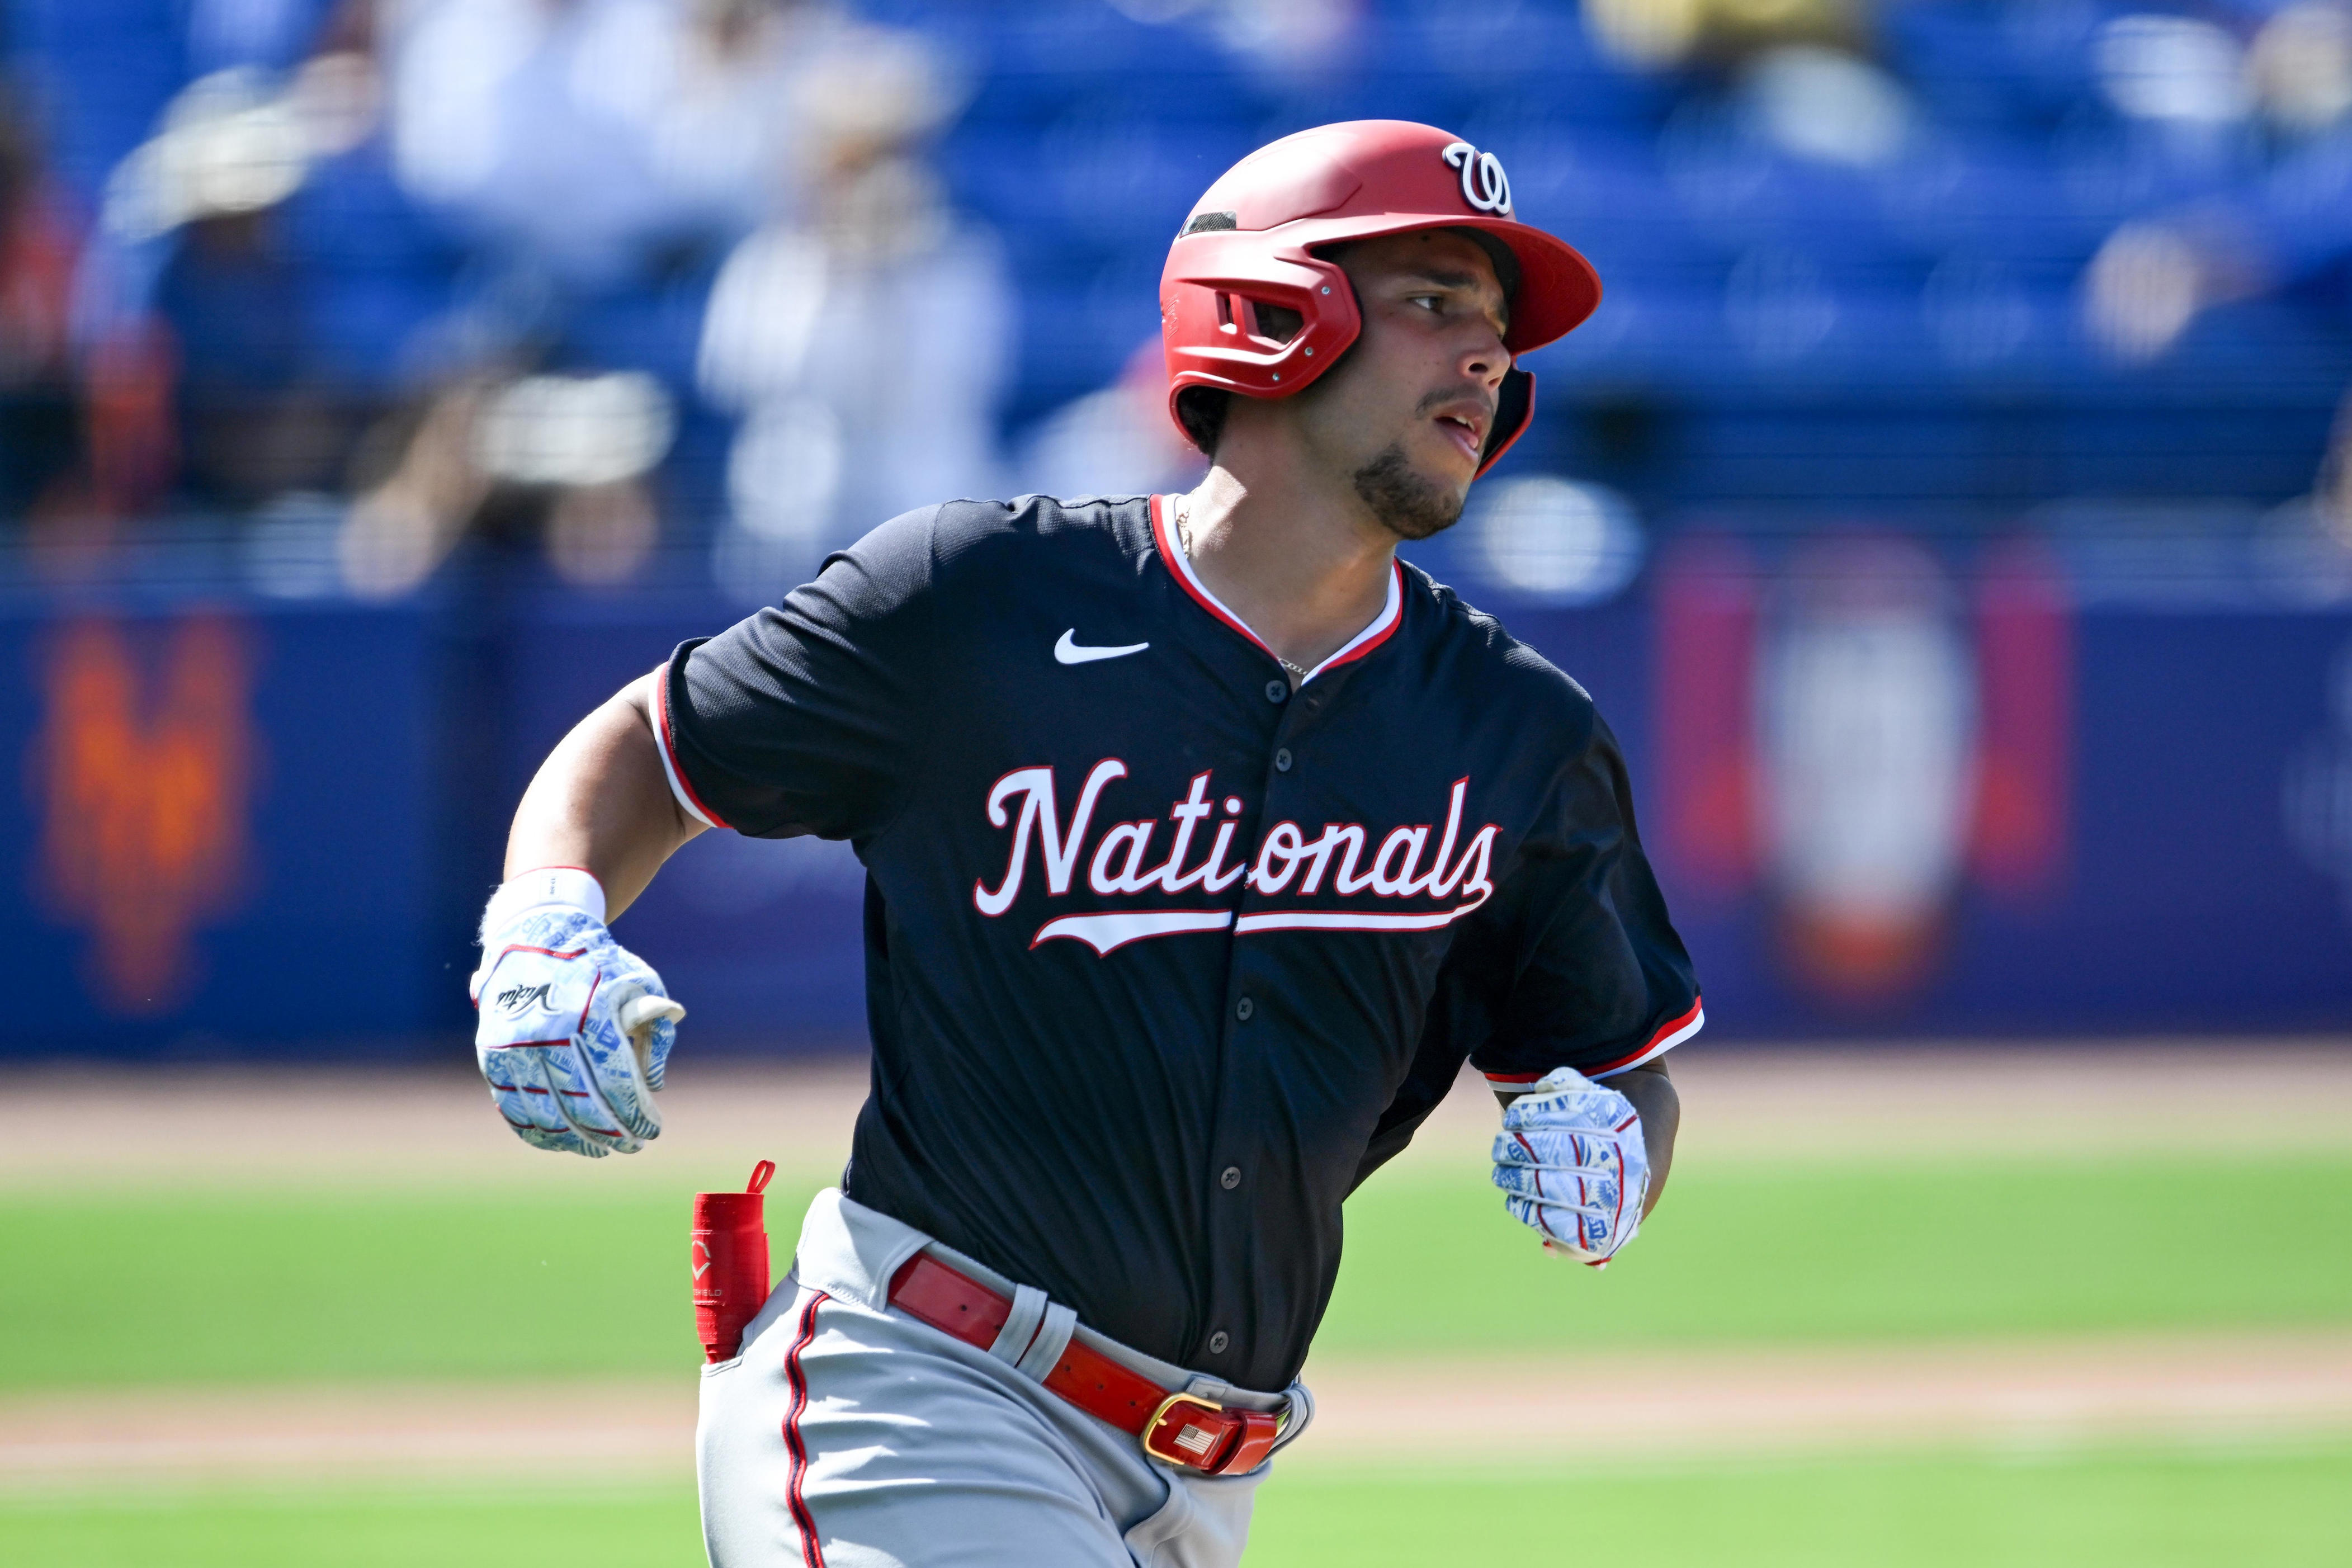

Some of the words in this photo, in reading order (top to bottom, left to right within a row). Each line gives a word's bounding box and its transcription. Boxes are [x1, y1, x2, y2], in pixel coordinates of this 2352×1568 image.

[1442, 142, 1511, 216] W
[974, 757, 1503, 917] Nationals
[495, 983, 560, 1015] Victus
